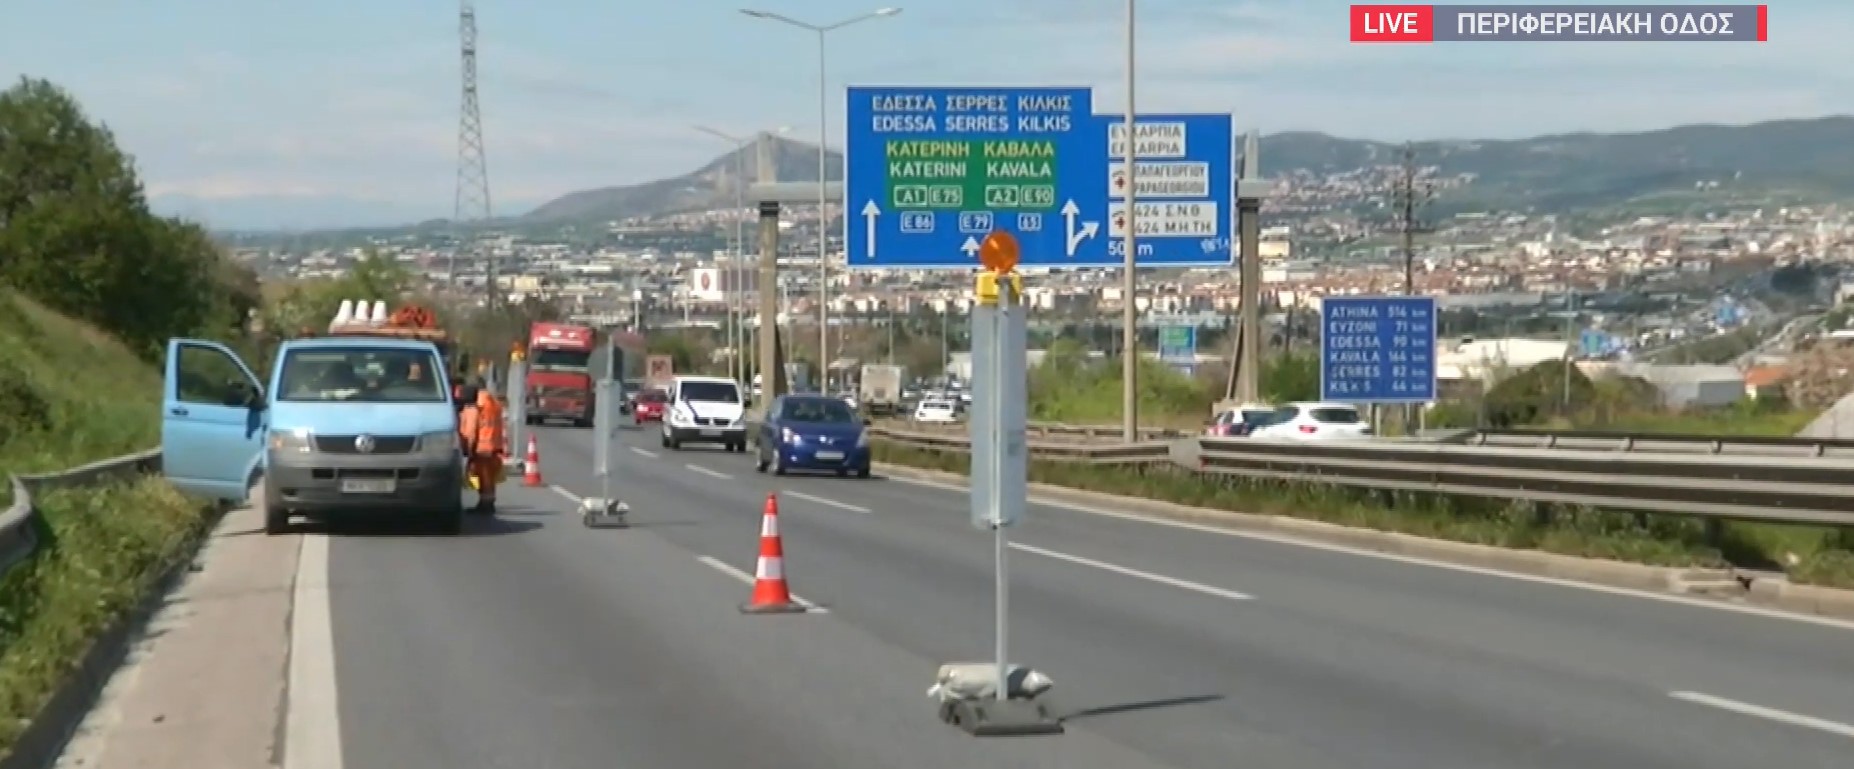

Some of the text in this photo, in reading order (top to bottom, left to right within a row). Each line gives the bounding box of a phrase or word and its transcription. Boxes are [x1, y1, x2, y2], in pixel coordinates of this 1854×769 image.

[872, 95, 1072, 112] ΕΔΕΣΣΑ ΣΕΡΡΕΣ ΚΙΛΚΙΣ
[872, 115, 1071, 132] EDESSA SERRES KILKIS
[886, 141, 1055, 157] ΚΑΤΕΡΙΝΗ ΚΑΒΑΛΑ
[889, 161, 1052, 178] KATERINI KAVALA
[902, 189, 920, 203] A1
[992, 189, 1013, 203] A2
[1137, 243, 1153, 256] m
[1330, 306, 1378, 318] ATHINA
